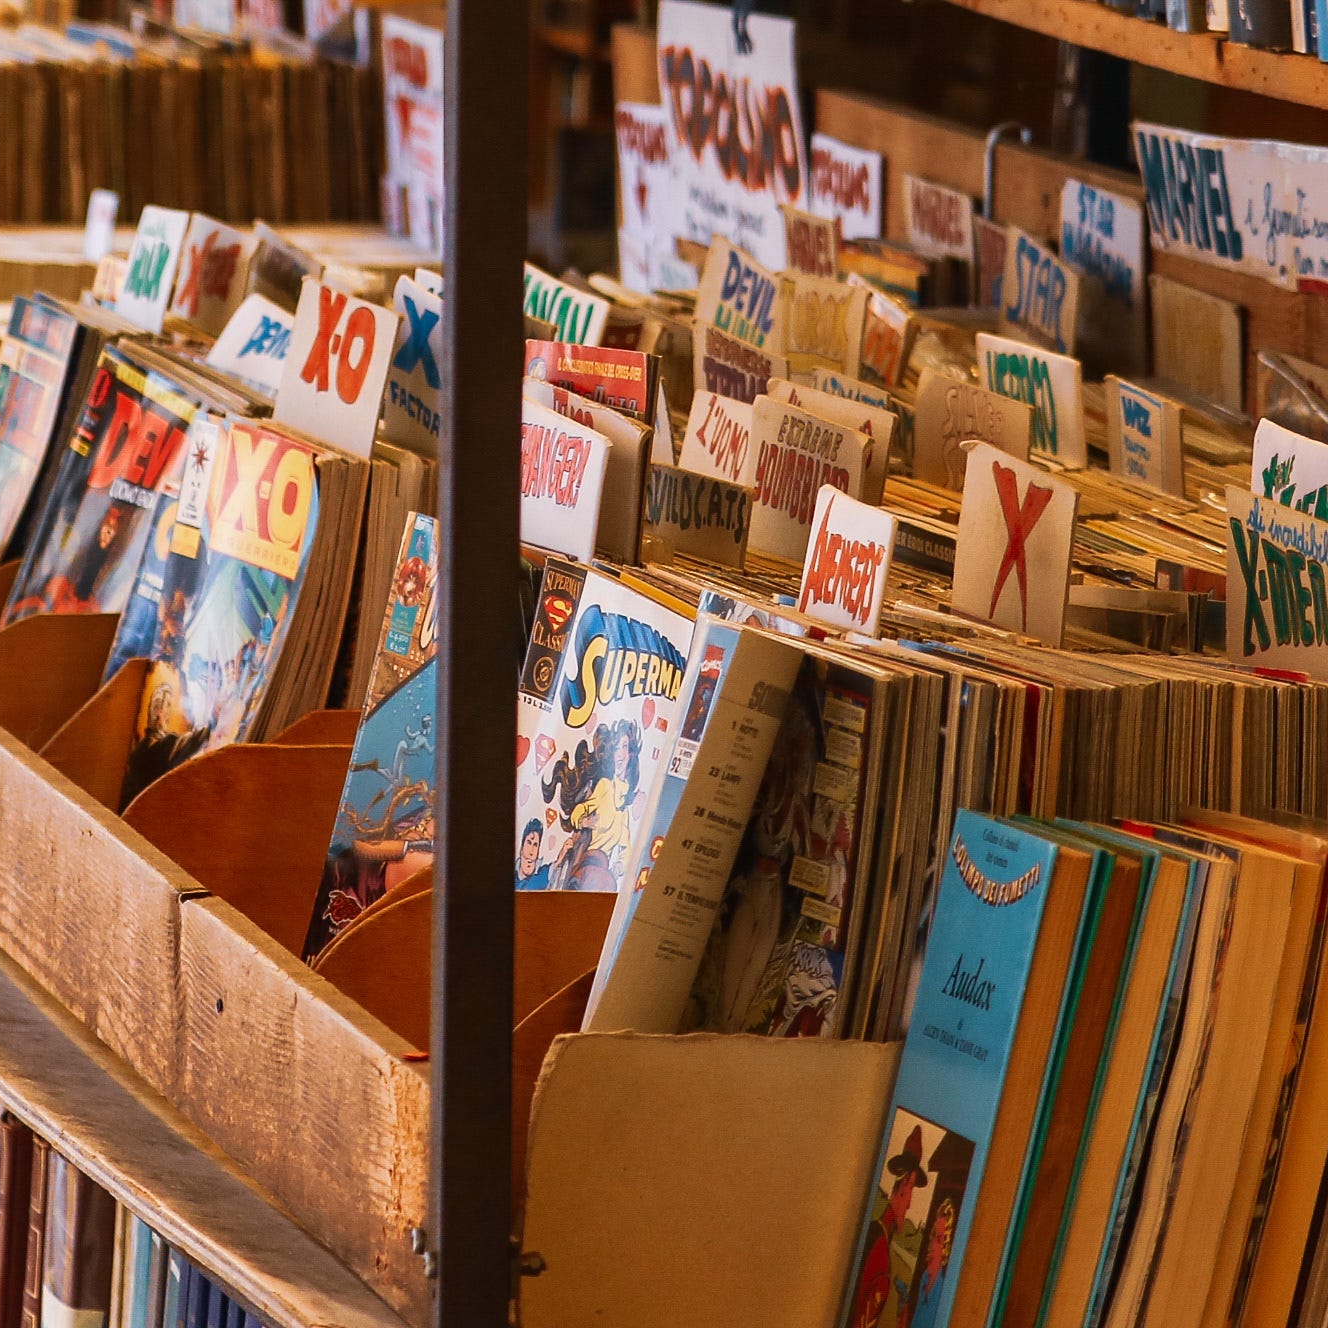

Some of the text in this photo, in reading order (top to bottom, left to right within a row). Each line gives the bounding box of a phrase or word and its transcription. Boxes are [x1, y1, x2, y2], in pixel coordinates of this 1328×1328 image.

[1136, 131, 1242, 262] MARVEL
[300, 285, 373, 405] X-O
[393, 294, 440, 389] X
[778, 414, 844, 462] EXTREME
[799, 494, 886, 626] AVENGERS
[989, 460, 1054, 633] X
[566, 630, 683, 728] SUPERMA
[952, 833, 1040, 906] L'OLIMPO DEI FUMETTI
[942, 953, 996, 1011] Audax
